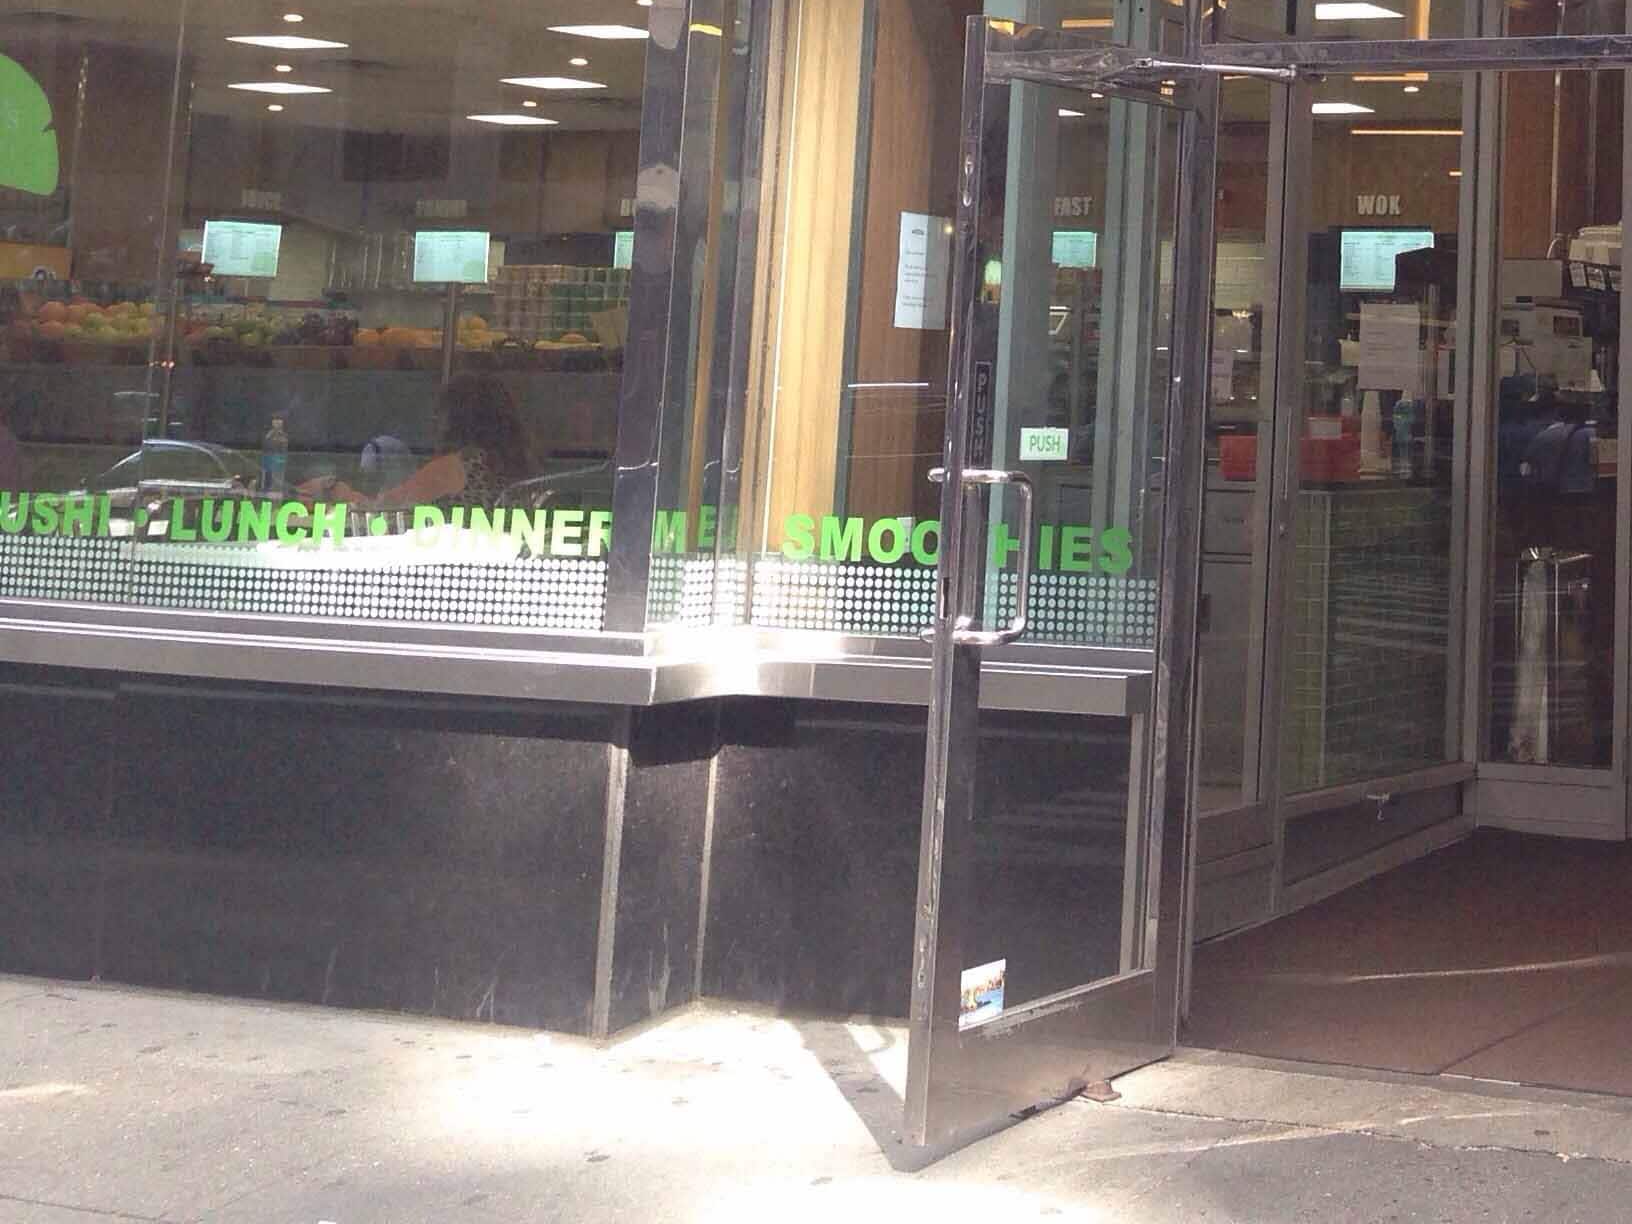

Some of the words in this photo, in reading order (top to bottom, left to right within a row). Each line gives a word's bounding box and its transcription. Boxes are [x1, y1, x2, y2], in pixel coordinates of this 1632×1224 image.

[1356, 194, 1402, 216] WOK
[1029, 434, 1062, 453] PUSH
[169, 496, 349, 548] LUNCH
[412, 505, 613, 558] DINNER
[781, 513, 1135, 574] SMOOHIES
